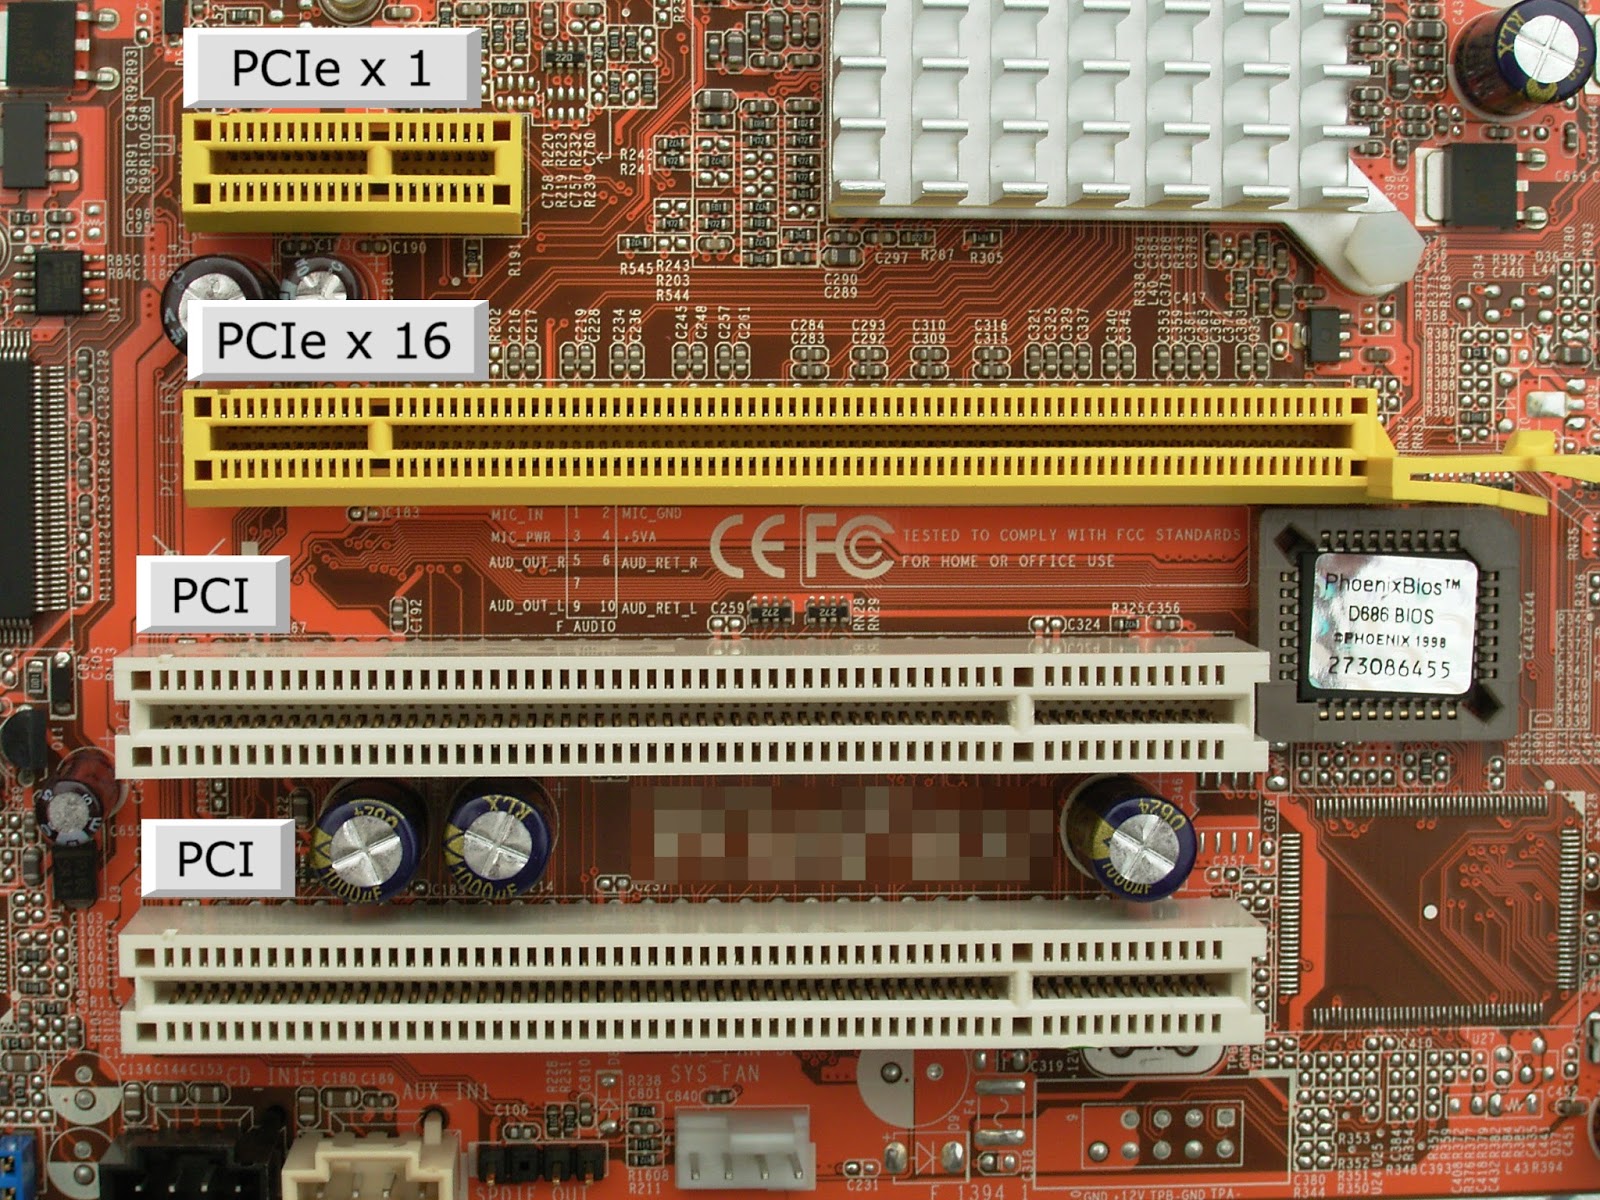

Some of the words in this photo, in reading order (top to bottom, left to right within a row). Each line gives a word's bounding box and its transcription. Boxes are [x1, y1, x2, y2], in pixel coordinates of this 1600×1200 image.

[542, 133, 554, 167] R220
[555, 133, 568, 167] R223
[570, 132, 582, 167] R232
[584, 132, 596, 167] C760
[620, 149, 653, 161] R242
[620, 163, 652, 176] R241
[542, 174, 554, 209] C758
[555, 174, 568, 209] R219
[570, 174, 582, 209] C757
[584, 174, 596, 208] R239
[1563, 226, 1575, 258] R780
[656, 260, 690, 272] R243
[875, 252, 909, 264] C297
[970, 252, 1004, 264] R305
[1492, 253, 1524, 266] R392
[620, 263, 653, 275] R545
[1492, 266, 1524, 279] C440
[656, 275, 690, 287] R203
[824, 273, 858, 285] C290
[656, 288, 690, 301] R544
[824, 287, 858, 298] C289
[1134, 272, 1146, 306] R338
[1147, 280, 1159, 306] L40
[1160, 273, 1172, 307] C379
[675, 305, 688, 339] C245
[695, 305, 708, 339] C248
[718, 305, 731, 339] C257
[738, 305, 751, 339] C261
[1028, 307, 1040, 341] C321
[1044, 307, 1056, 341] C325
[1060, 307, 1073, 341] C329
[1077, 307, 1089, 341] C337
[1415, 309, 1447, 321] R368
[508, 308, 521, 343] C216
[525, 308, 538, 343] C217
[575, 308, 587, 343] C219
[588, 308, 601, 343] C228
[613, 308, 625, 343] C234
[629, 308, 642, 343] C236
[791, 319, 824, 331] C284
[852, 319, 886, 331] C293
[912, 319, 946, 331] C310
[974, 319, 1008, 331] C316
[1106, 309, 1118, 343] C340
[1119, 309, 1131, 343] C345
[1158, 309, 1170, 343] C353
[1171, 309, 1183, 343] C359
[1209, 309, 1221, 343] C367
[1222, 309, 1235, 343] C374
[1236, 309, 1248, 343] C383
[791, 333, 825, 344] C283
[852, 333, 886, 344] C292
[912, 333, 946, 344] C309
[974, 332, 1008, 344] C315
[602, 507, 610, 519] 2
[573, 530, 580, 542] 3
[602, 530, 610, 542] 4
[903, 529, 960, 542] TESTED
[971, 530, 989, 542] TO
[1000, 529, 1057, 541] COMPLY
[1067, 528, 1107, 541] WITH
[1116, 528, 1144, 540] FCC
[1156, 528, 1241, 540] STANDARDS
[710, 514, 785, 579] CE
[573, 554, 581, 566] 5
[602, 554, 610, 566] 6
[902, 555, 930, 568] FOR
[941, 555, 978, 568] HOME
[989, 555, 1008, 568] OR
[1018, 555, 1076, 568] OFFICE
[1087, 554, 1115, 567] USE
[573, 577, 580, 590] 7
[573, 601, 581, 613] 9
[600, 600, 616, 613] 10
[711, 602, 745, 614] C259
[853, 597, 865, 631] RN28
[868, 597, 880, 631] RN29
[1112, 602, 1145, 614] R325
[1147, 602, 1180, 614] C356
[410, 599, 422, 633] C192
[1067, 618, 1101, 631] C324
[1395, 607, 1434, 625] BIOS
[1416, 635, 1447, 649] 1998
[1328, 656, 1451, 679] 273086455
[1263, 799, 1275, 833] C376
[1401, 1037, 1433, 1049] C410
[1338, 1132, 1371, 1145] R353
[1390, 1128, 1402, 1162] C384
[1402, 1129, 1414, 1162] R354
[1338, 1157, 1370, 1169] R352
[846, 1178, 878, 1190] C231
[1293, 1174, 1326, 1186] C380
[1337, 1182, 1370, 1194] R350
